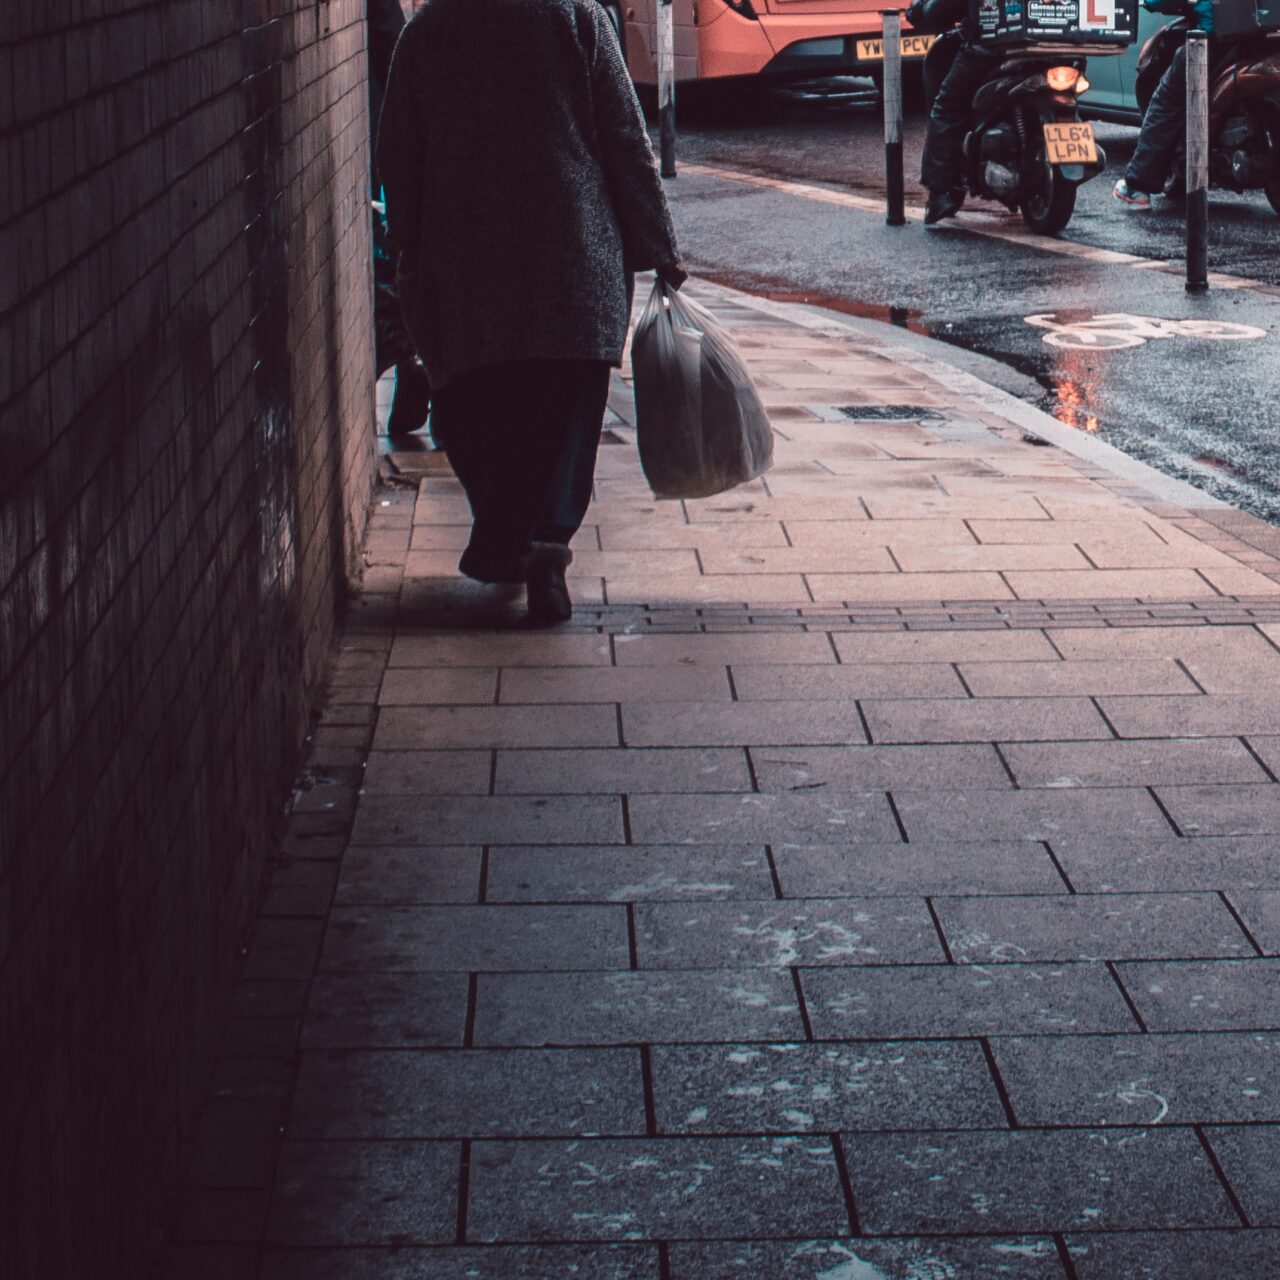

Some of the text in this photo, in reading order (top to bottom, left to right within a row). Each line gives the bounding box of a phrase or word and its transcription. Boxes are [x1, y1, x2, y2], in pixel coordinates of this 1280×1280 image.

[903, 37, 929, 53] PCV
[1046, 127, 1091, 142] LL64
[1055, 143, 1089, 158] LPN
